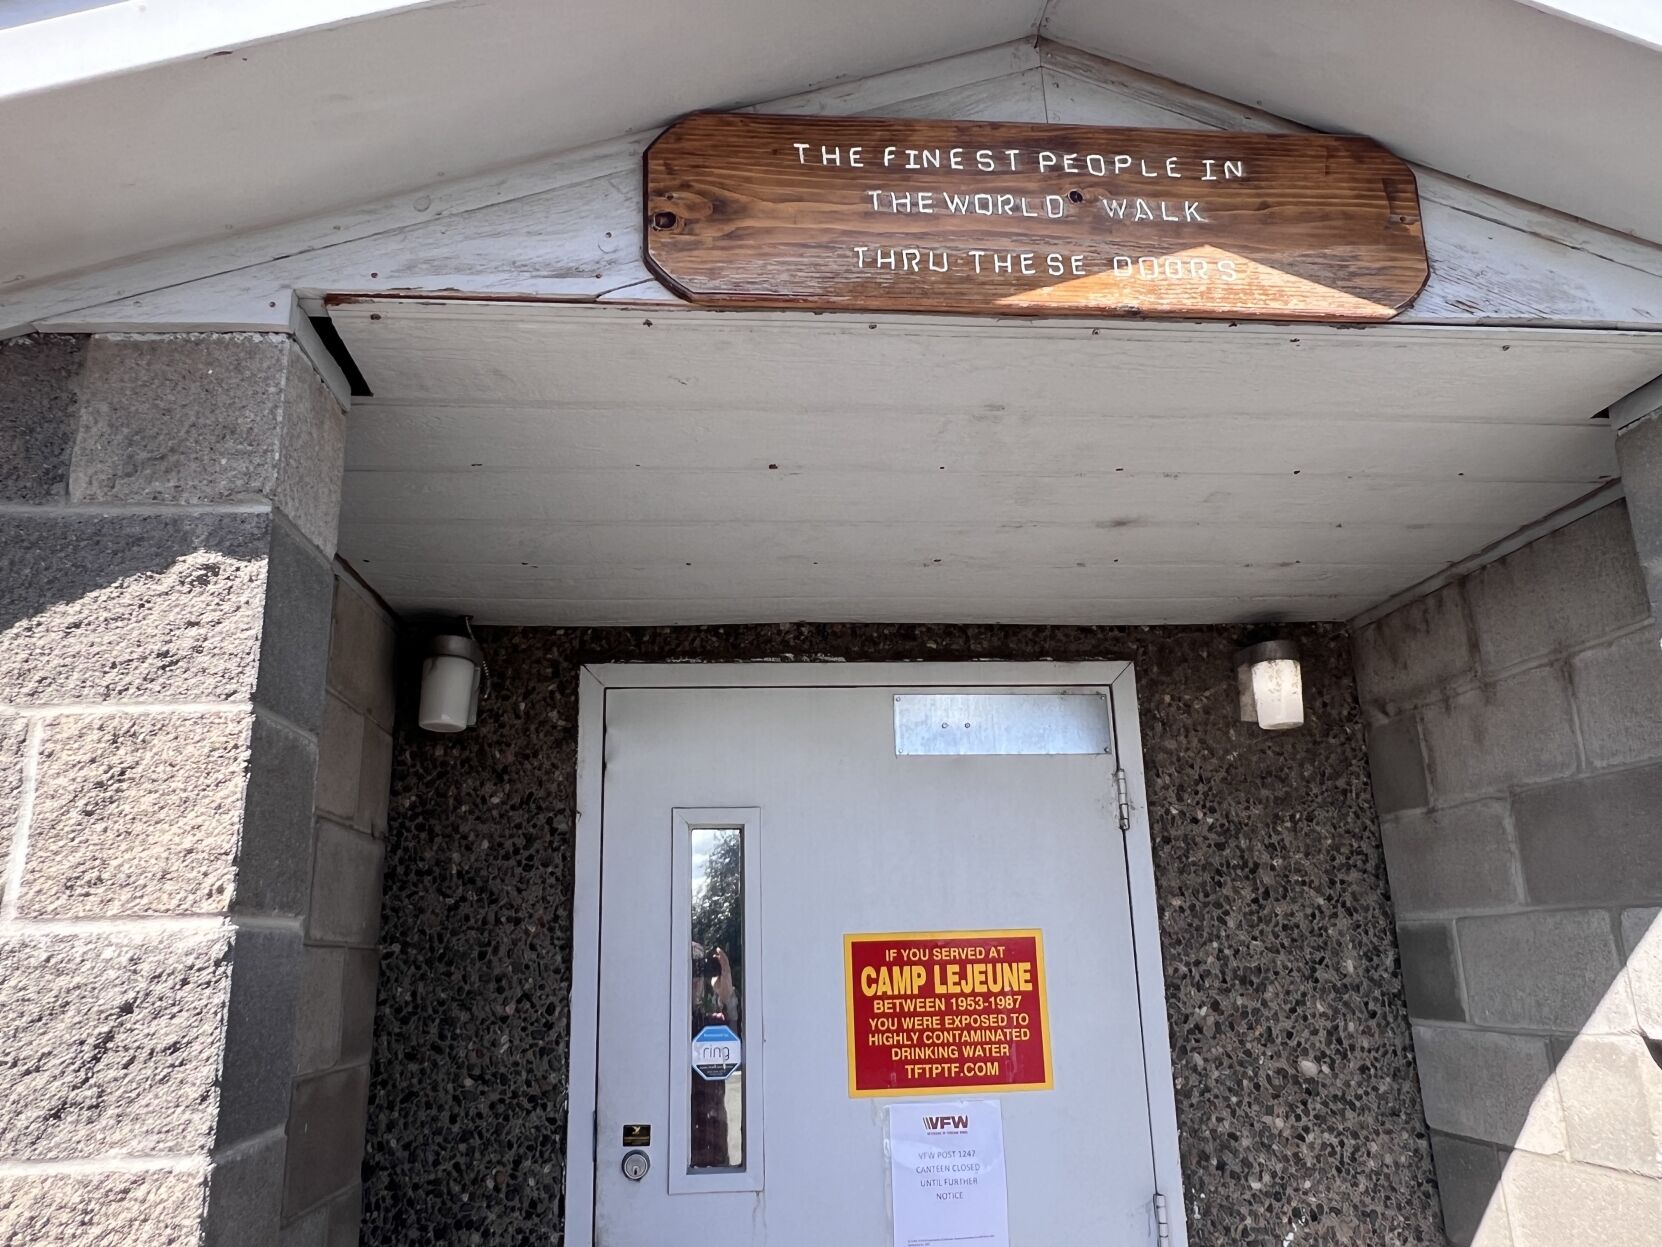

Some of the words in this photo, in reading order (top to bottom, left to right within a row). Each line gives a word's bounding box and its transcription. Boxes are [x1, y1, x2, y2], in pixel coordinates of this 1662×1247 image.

[793, 143, 863, 167] THE
[883, 146, 1020, 172] FINEST
[1039, 151, 1181, 178] PEOPLE
[1200, 158, 1244, 181] IN
[867, 189, 935, 214] THE
[943, 192, 1065, 219] WORLD
[1101, 197, 1208, 222] WALK
[853, 246, 948, 273] THRU
[969, 250, 1087, 276] THESE
[1112, 256, 1237, 281] DOORS
[885, 949, 898, 962] IF
[901, 948, 929, 961] YOU
[932, 947, 985, 960] SERVED
[988, 946, 1006, 959] AT
[860, 965, 927, 996] CAMP
[933, 962, 1033, 994] LEJEUNE
[873, 998, 946, 1013] BETWEEN
[950, 995, 1022, 1011] 1953-1987
[869, 1018, 898, 1031] YOU
[901, 1016, 941, 1029] WERE
[944, 1014, 1008, 1028] EXPOSED
[1010, 1013, 1029, 1025] TO
[868, 1032, 919, 1046] HIGHLY
[923, 1028, 1030, 1044] CONTAMINATED
[703, 1044, 730, 1061] ring
[891, 1046, 959, 1061] DRINKING
[962, 1044, 1010, 1058] WATER
[905, 1062, 999, 1079] TFTPTF.COM
[923, 1115, 969, 1130] VFW
[918, 1151, 935, 1160] VFW
[937, 1150, 956, 1159] POST
[958, 1149, 976, 1158] 1247
[916, 1165, 950, 1174] CANTEEN
[952, 1163, 980, 1172] CLOSED
[920, 1178, 942, 1187] UNTIL
[944, 1177, 978, 1186] FURTHER
[936, 1192, 964, 1200] NOTICE
